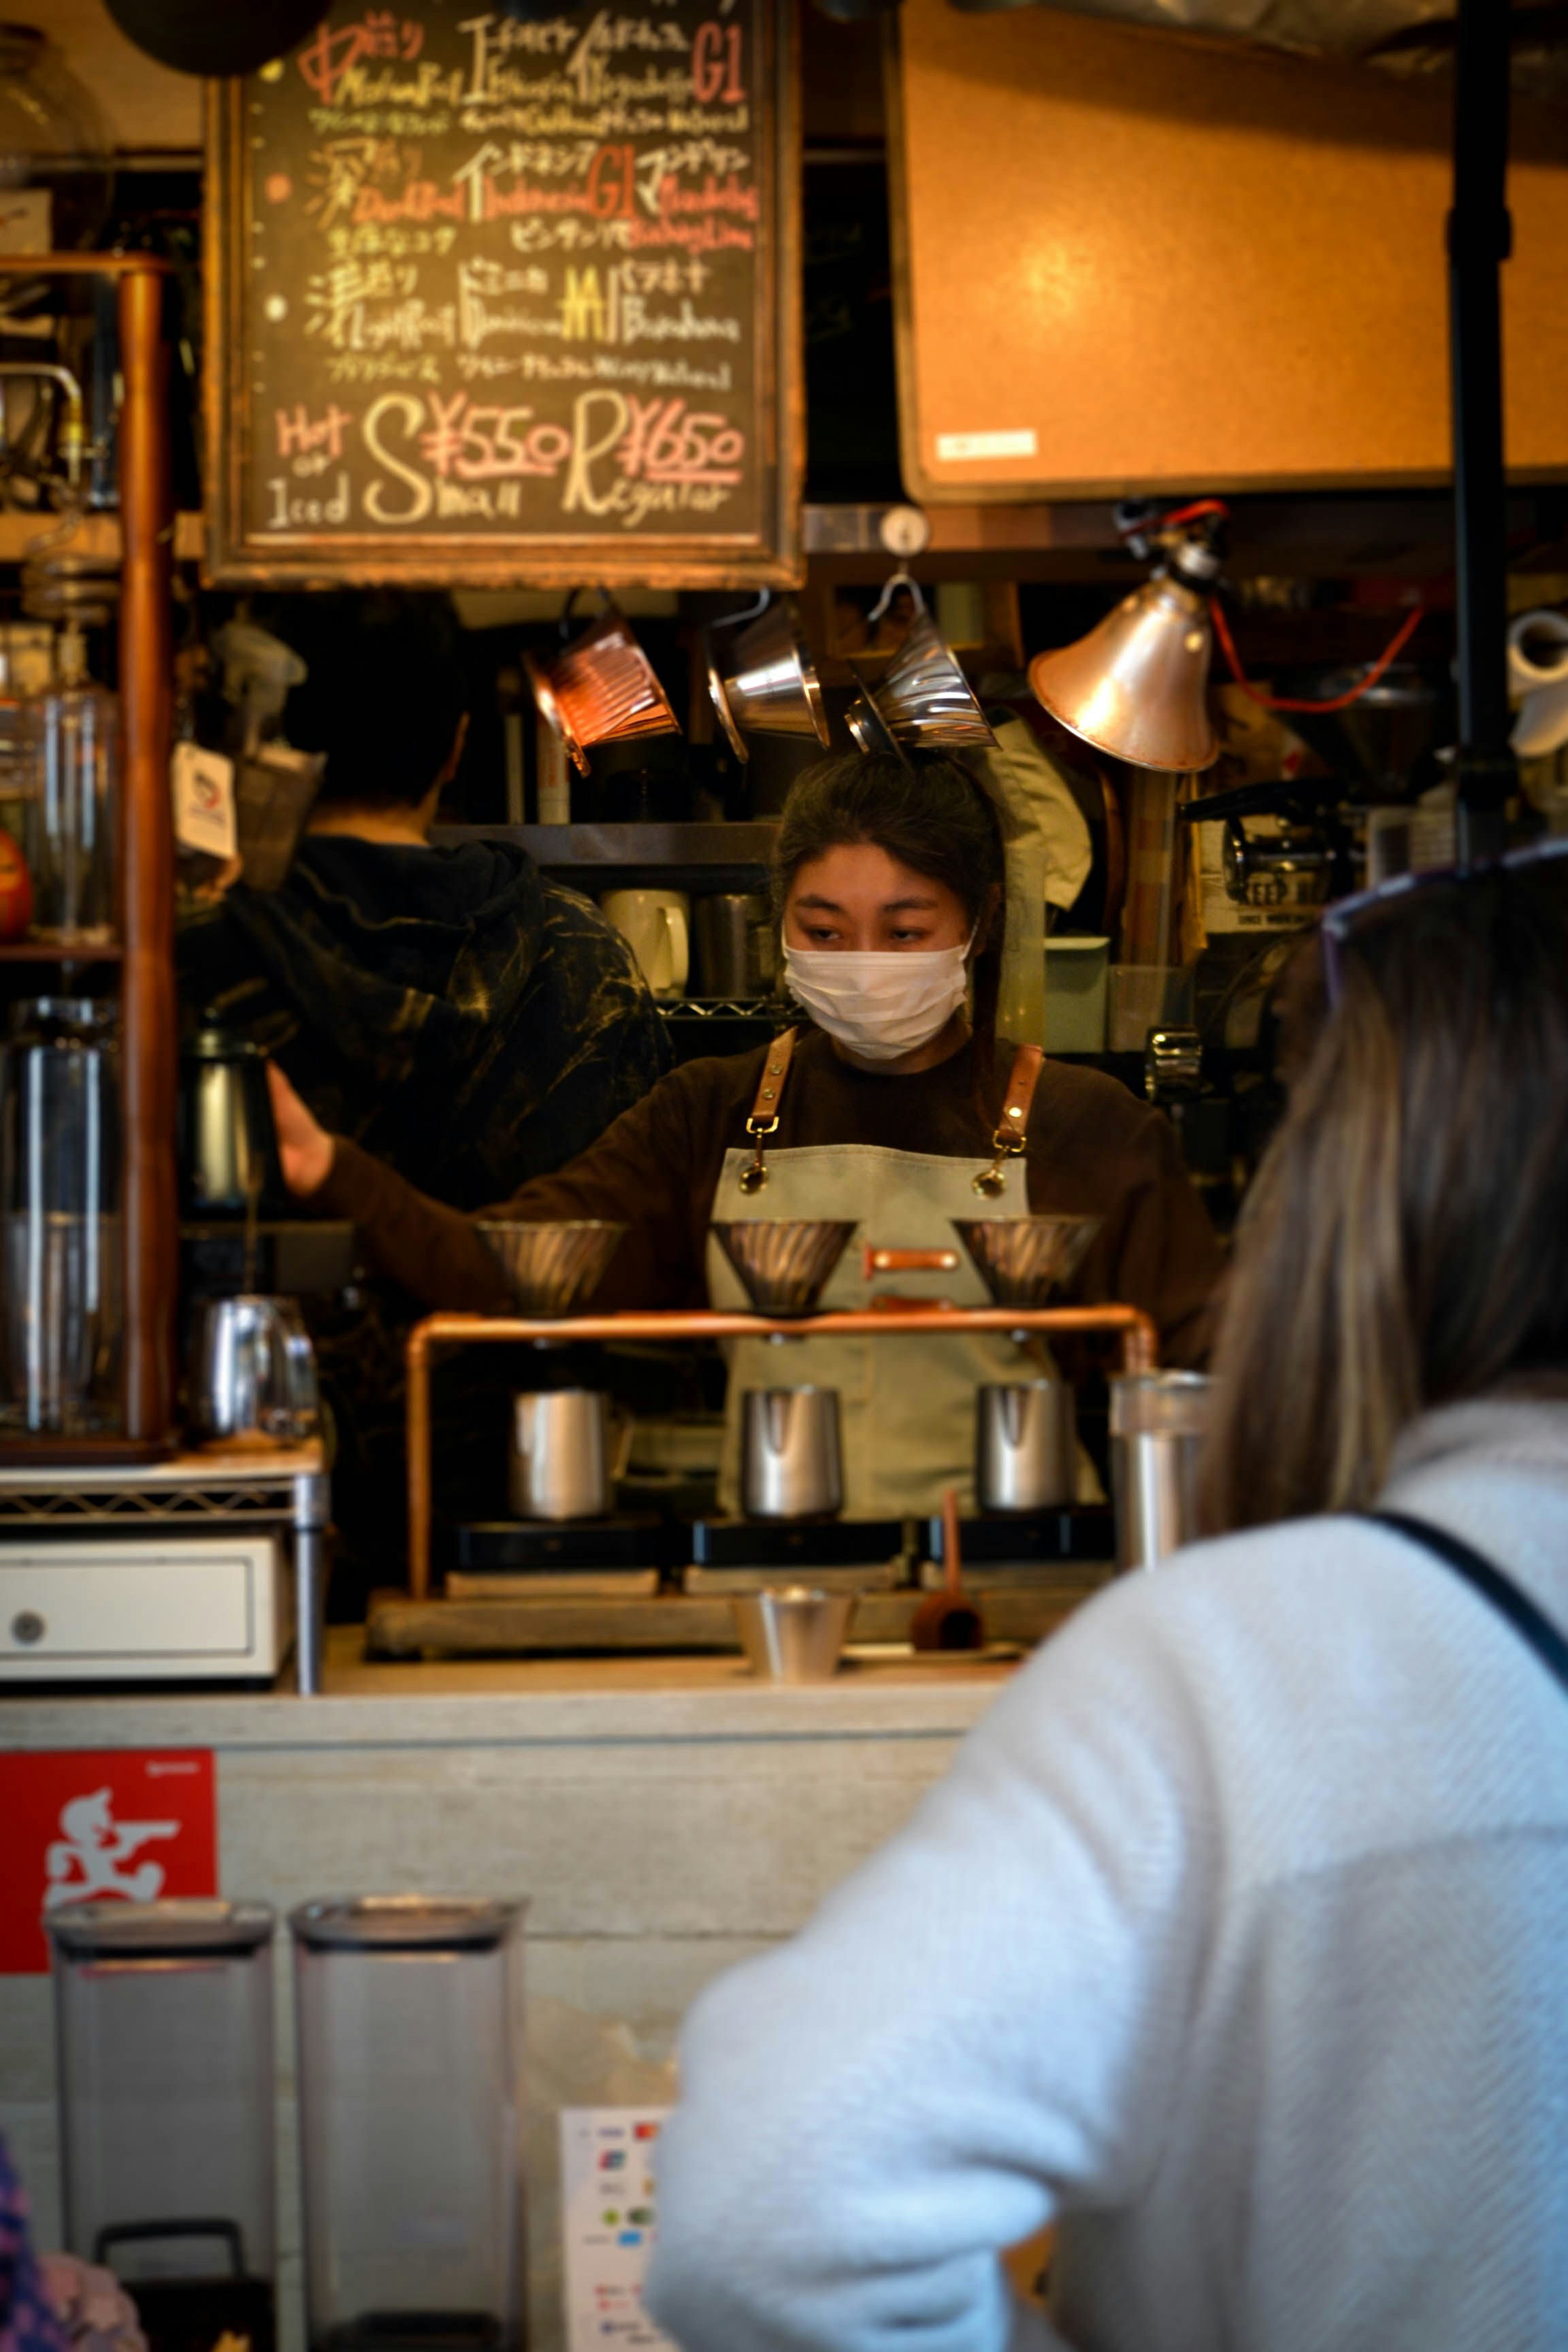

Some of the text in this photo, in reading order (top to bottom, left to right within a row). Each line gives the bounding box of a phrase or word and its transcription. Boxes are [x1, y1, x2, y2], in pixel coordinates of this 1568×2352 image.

[692, 20, 746, 103] G1
[276, 404, 351, 457] Hot
[362, 389, 570, 524] Small ¥550
[561, 388, 745, 528] Regular ¥650
[268, 472, 348, 528] Iced
